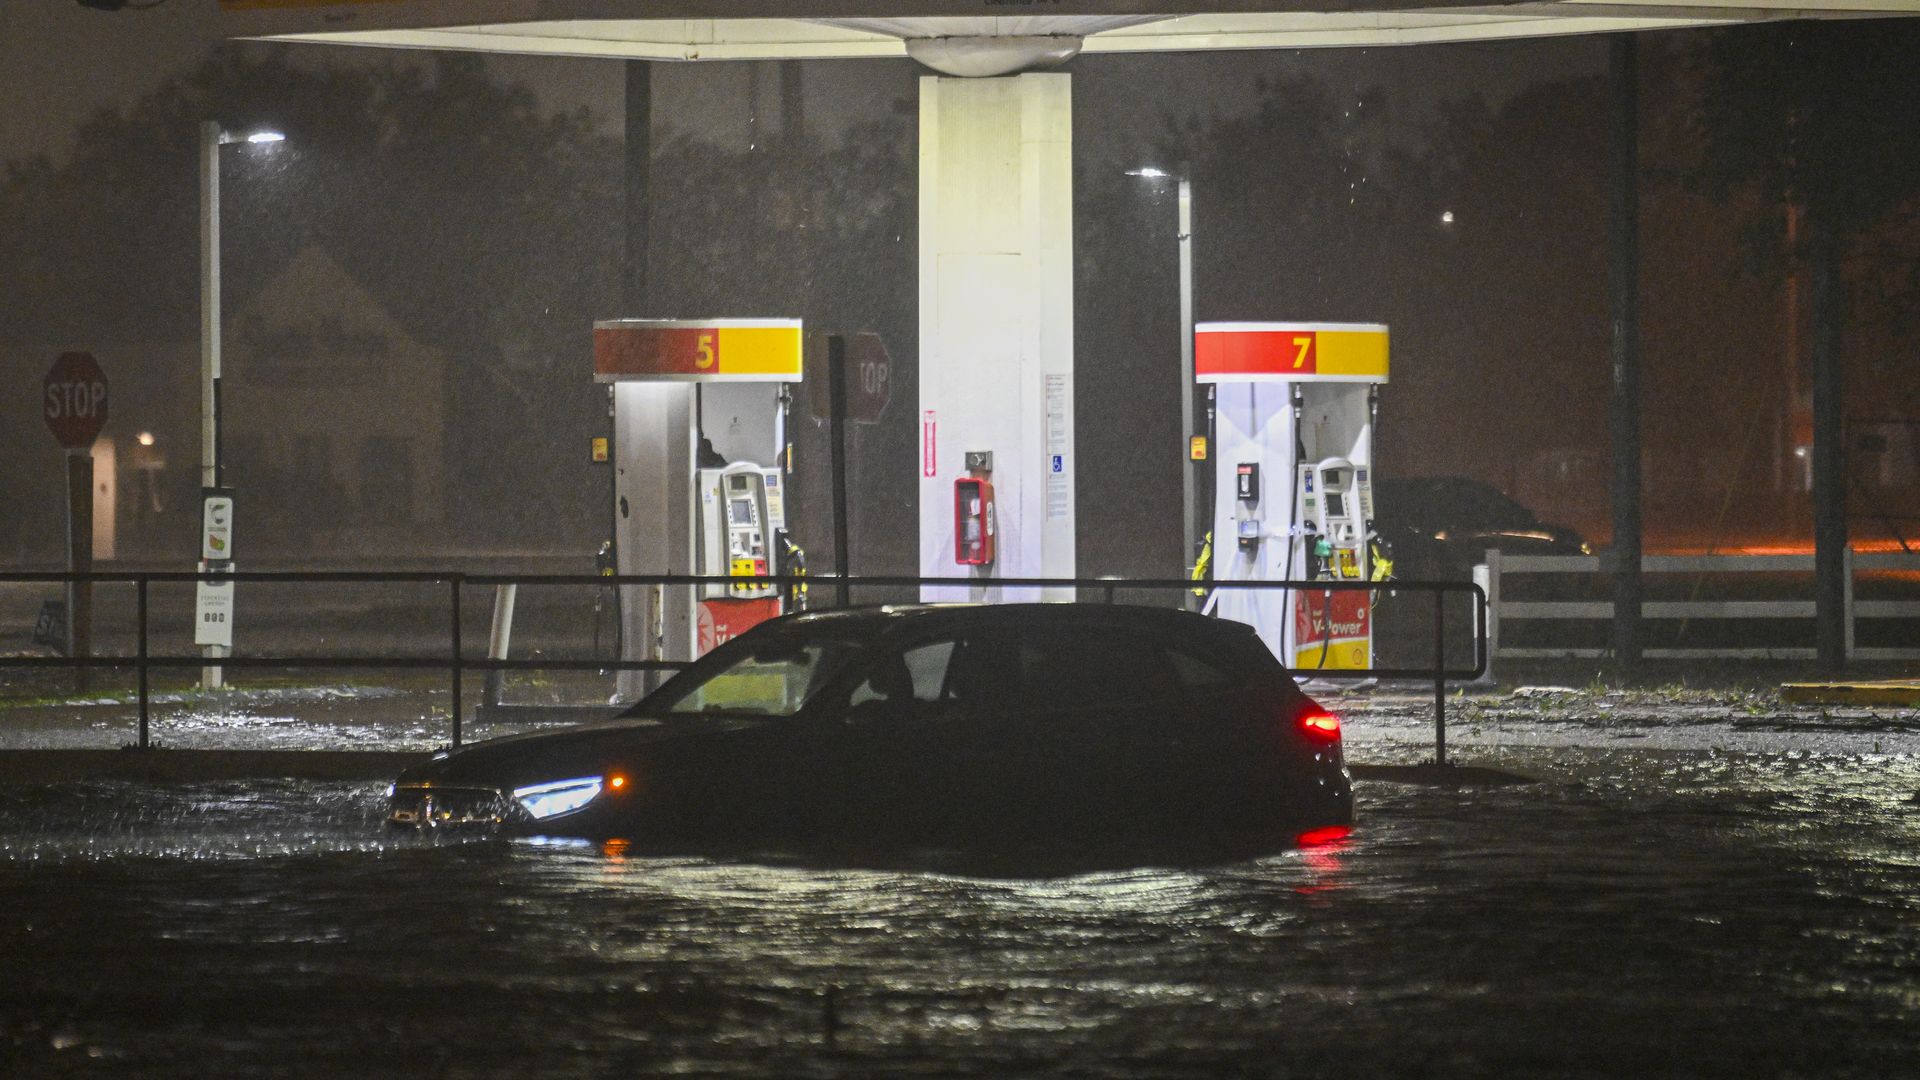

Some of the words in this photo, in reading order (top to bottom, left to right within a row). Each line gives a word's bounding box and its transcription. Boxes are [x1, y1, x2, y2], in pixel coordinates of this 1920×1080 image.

[695, 335, 714, 369] 5
[1293, 337, 1312, 369] 7
[860, 362, 888, 394] TOP
[47, 382, 105, 418] STOP
